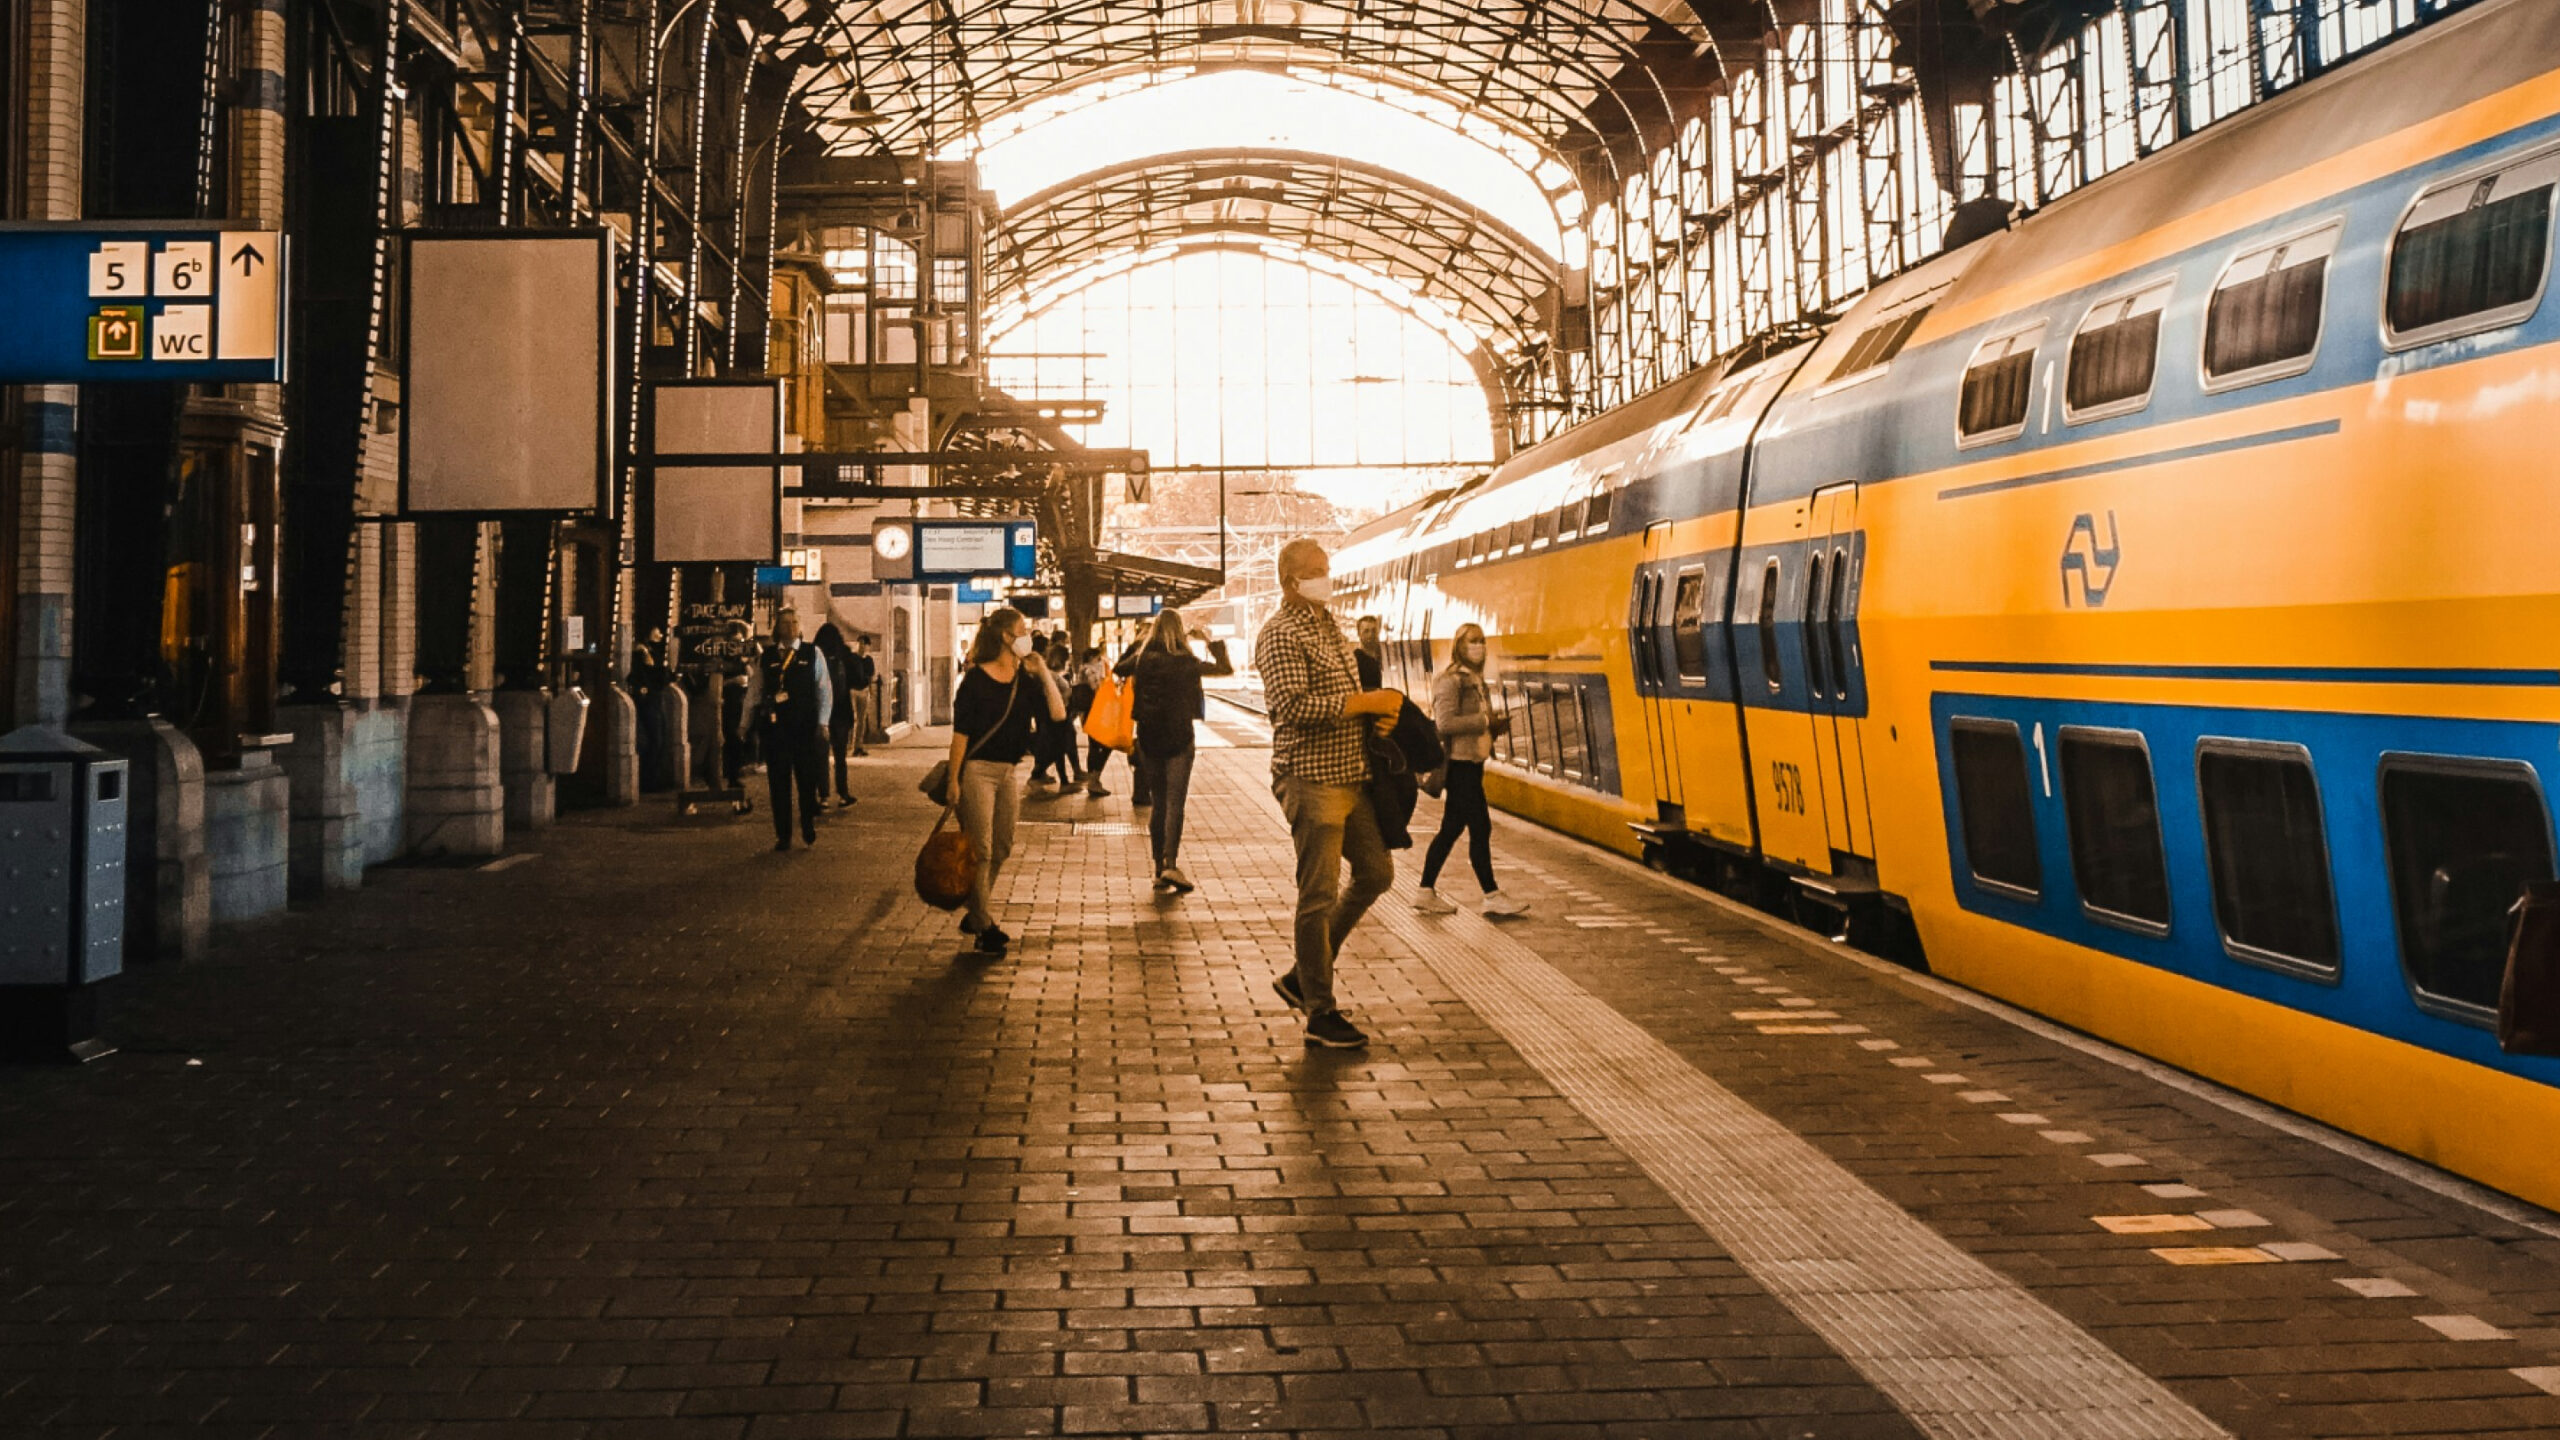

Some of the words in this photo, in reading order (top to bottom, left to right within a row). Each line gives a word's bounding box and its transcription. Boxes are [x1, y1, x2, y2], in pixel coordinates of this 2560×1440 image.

[106, 263, 125, 290] 5
[160, 335, 203, 354] WC
[2042, 360, 2054, 435] 1
[1128, 477, 1146, 501] V
[2033, 722, 2051, 797] 1
[1772, 760, 1804, 815] 9578
